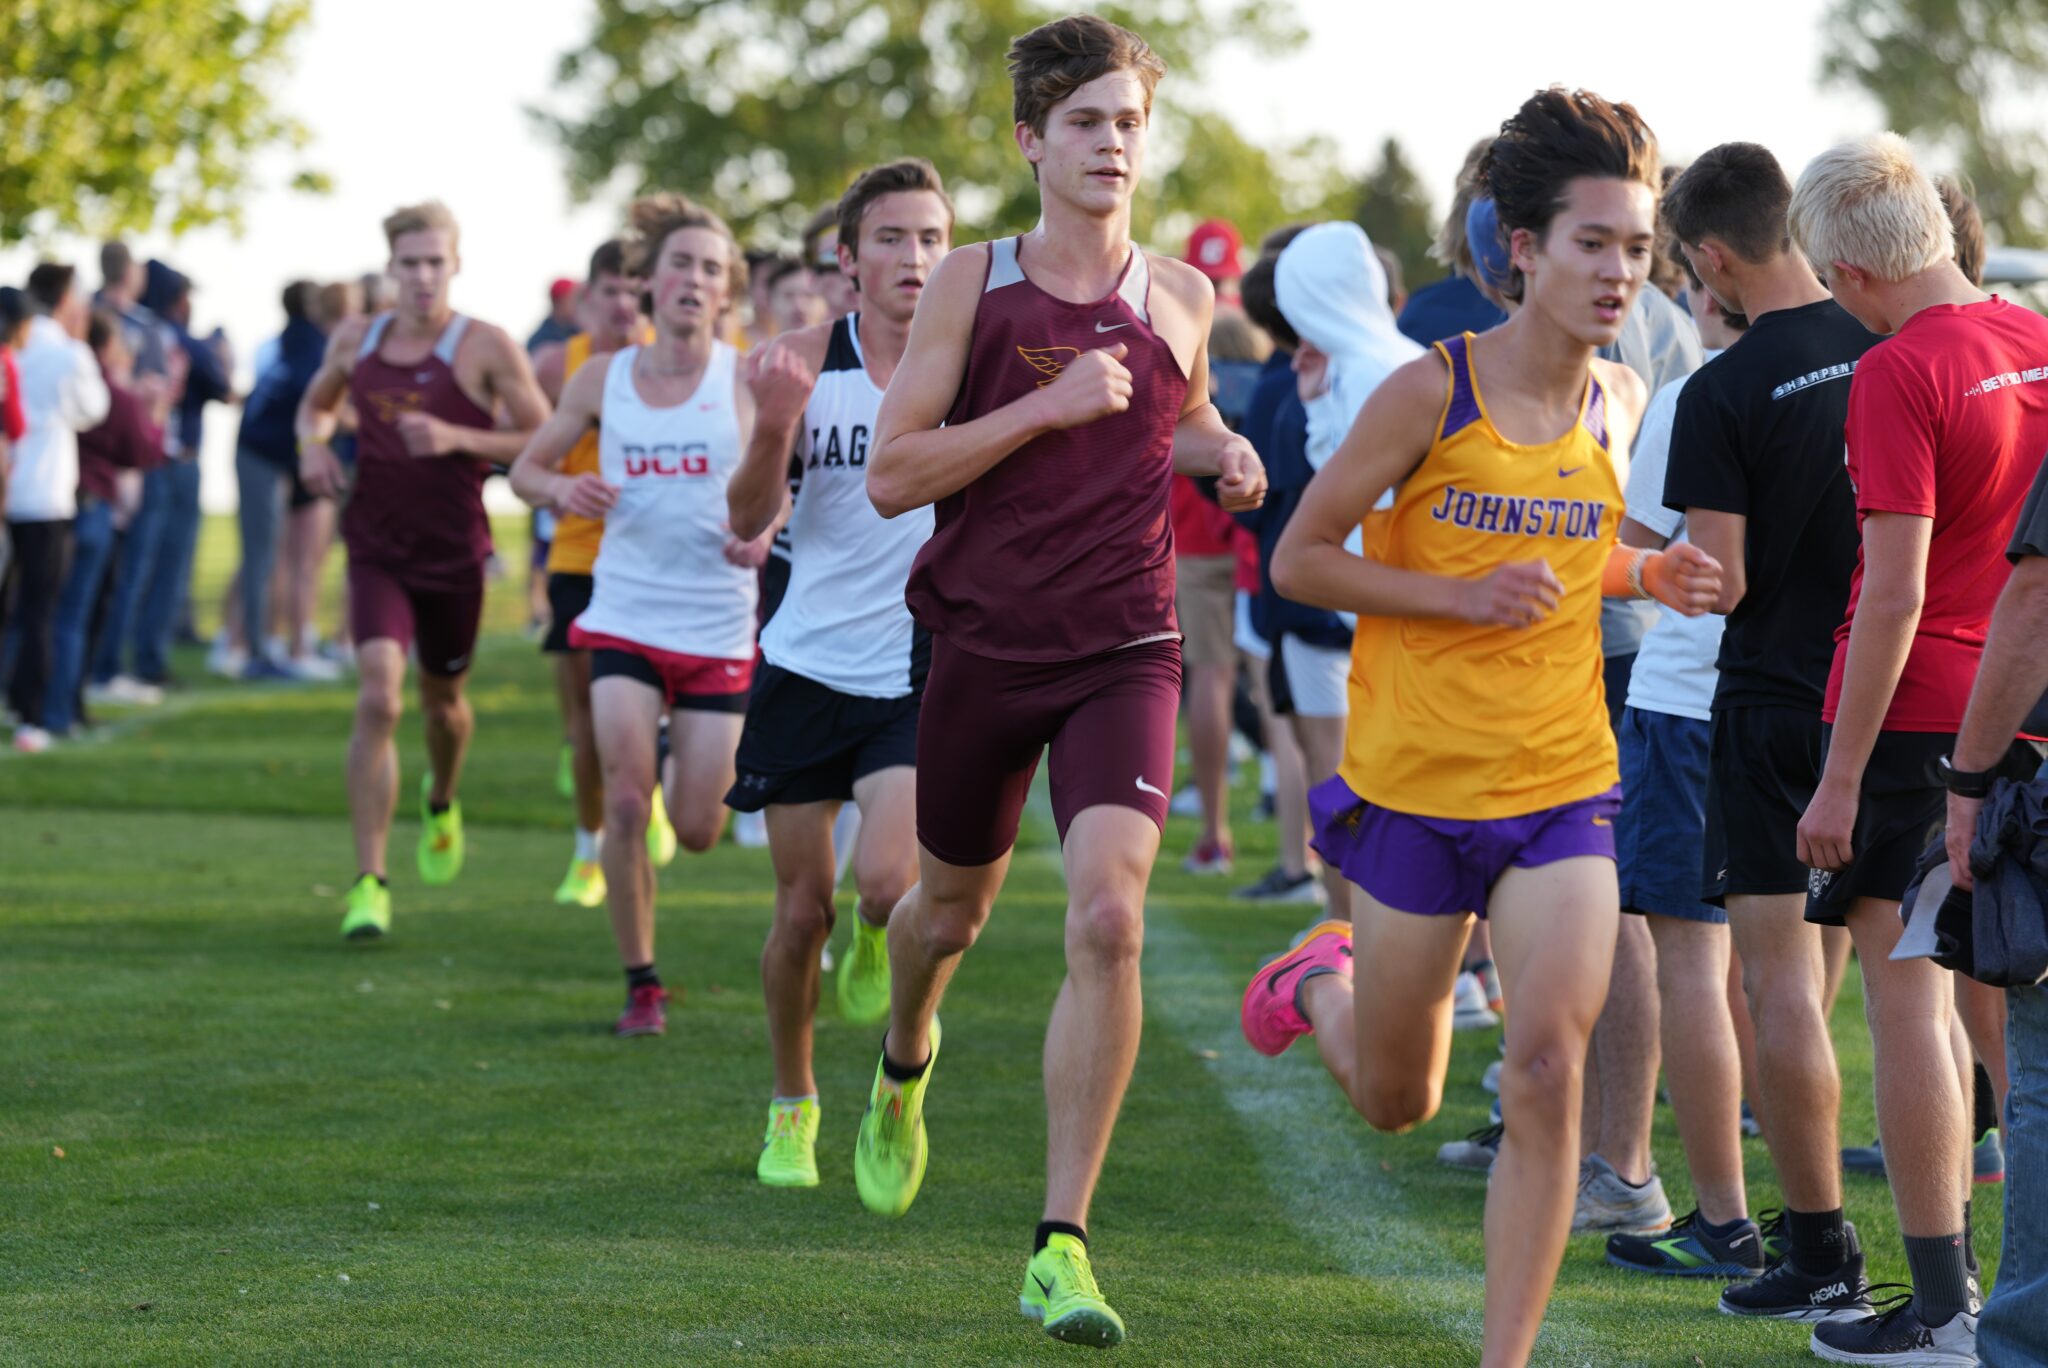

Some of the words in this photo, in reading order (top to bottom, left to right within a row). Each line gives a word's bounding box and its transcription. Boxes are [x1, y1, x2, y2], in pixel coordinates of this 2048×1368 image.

[1772, 360, 1859, 400] SHARPEN
[622, 442, 709, 477] DCG
[1432, 485, 1604, 539] JOHNSTON
[1809, 1281, 1849, 1306] HOKA
